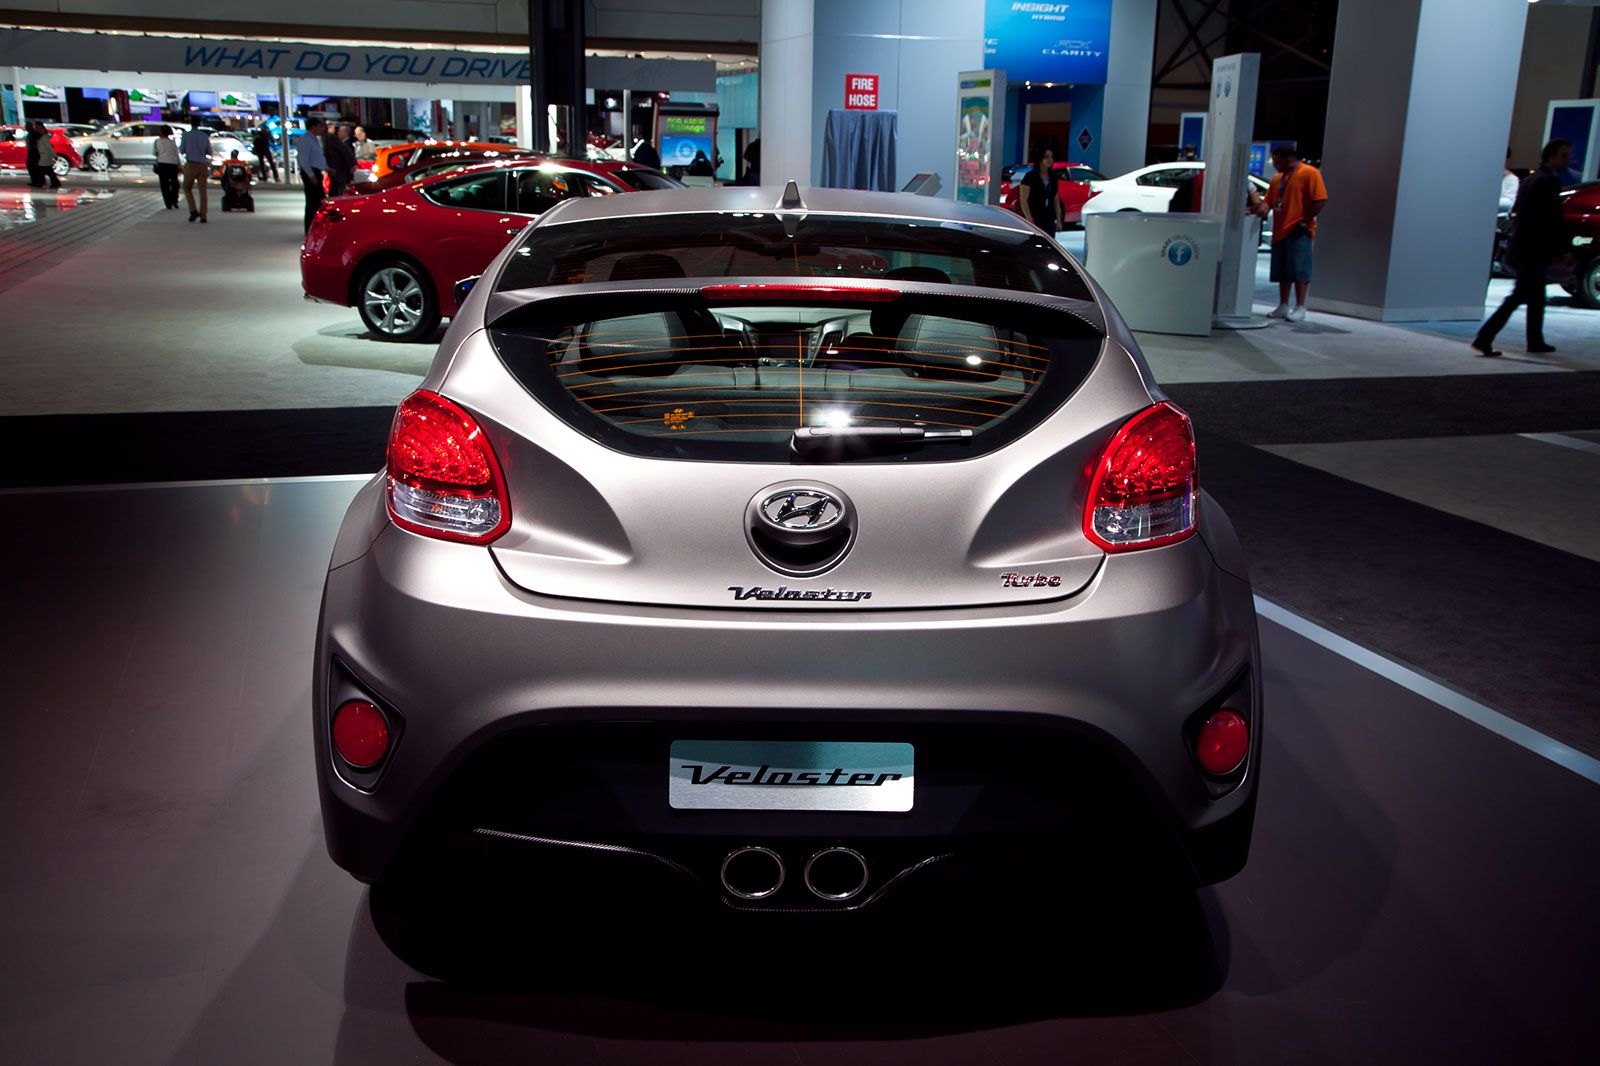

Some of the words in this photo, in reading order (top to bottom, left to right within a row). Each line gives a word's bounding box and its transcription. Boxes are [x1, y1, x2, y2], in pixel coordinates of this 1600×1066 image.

[1011, 2, 1069, 13] INSIGHT
[1041, 48, 1102, 57] CLARITY
[184, 46, 290, 70] WHAT
[294, 51, 351, 73] DO
[364, 53, 436, 76] YOU
[440, 57, 531, 80] DRIVE
[851, 78, 874, 90] FIRE
[849, 94, 876, 107] HOSE
[1001, 573, 1062, 587] Turbo
[728, 586, 873, 602] Veloster
[681, 765, 902, 786] Veloster
